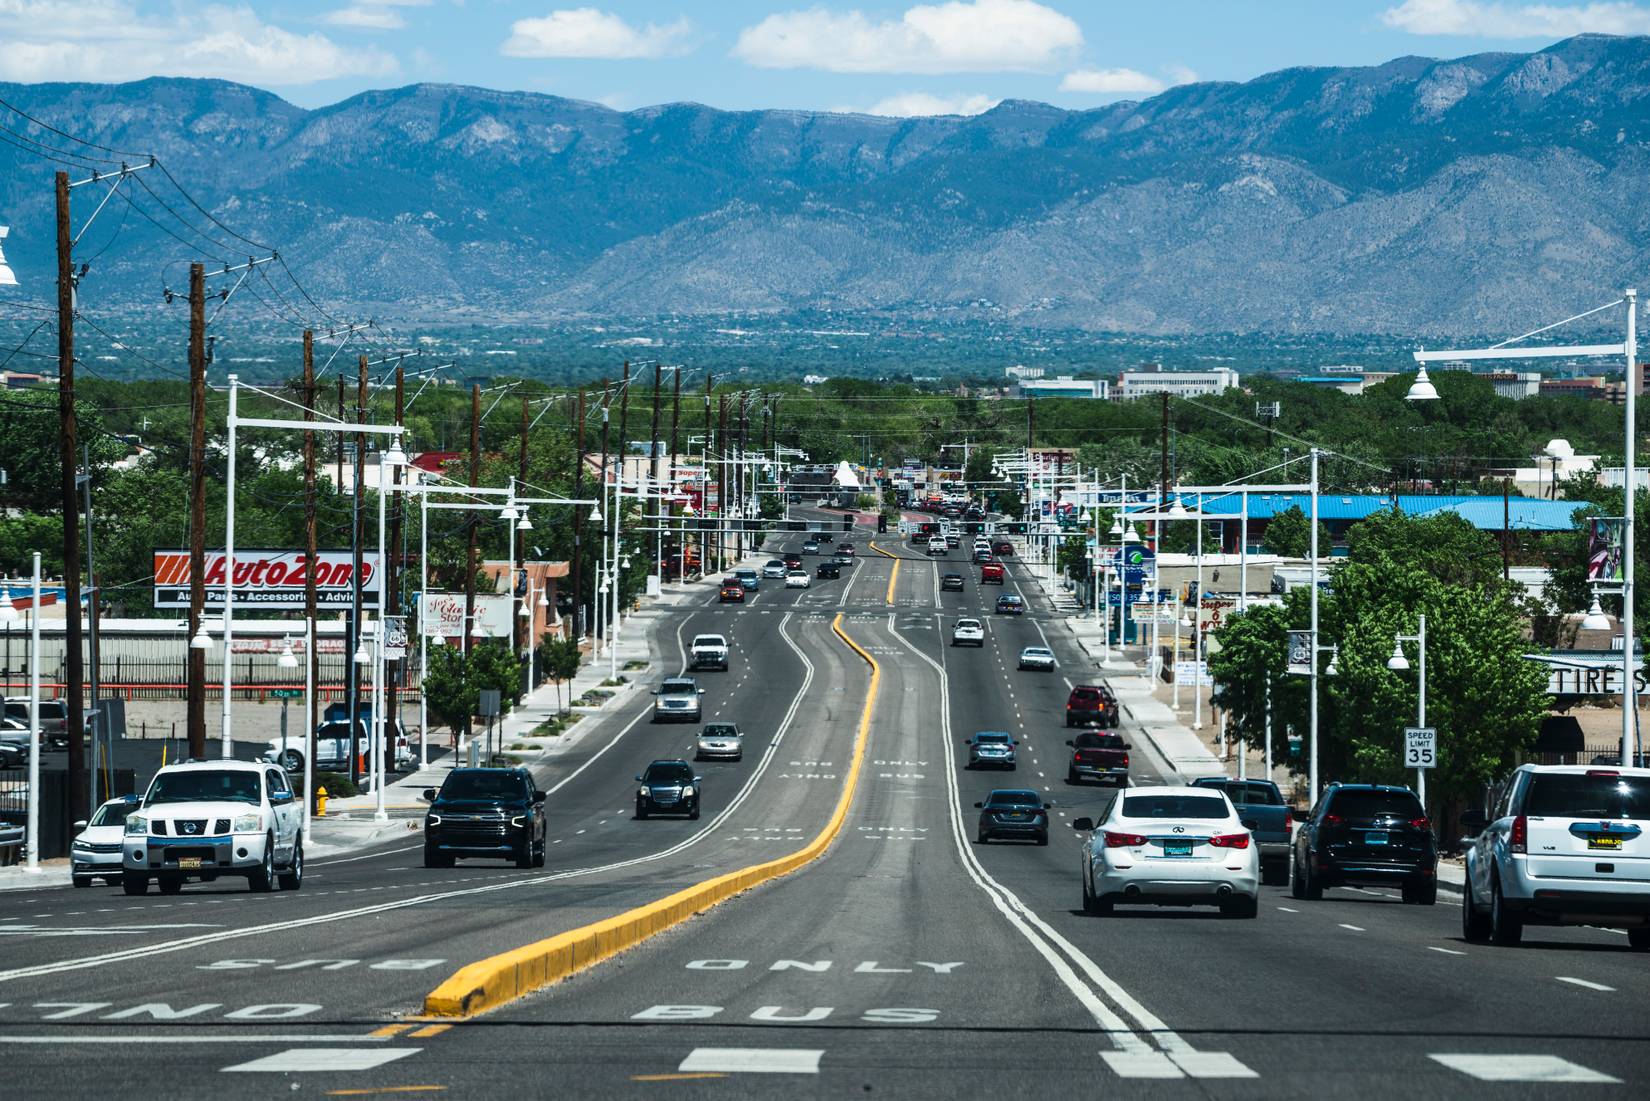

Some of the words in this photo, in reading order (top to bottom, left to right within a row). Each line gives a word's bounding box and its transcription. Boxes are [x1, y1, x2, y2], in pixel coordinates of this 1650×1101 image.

[1409, 749, 1432, 763] 35
[684, 959, 965, 973] ONLY
[629, 1004, 942, 1023] BUS
